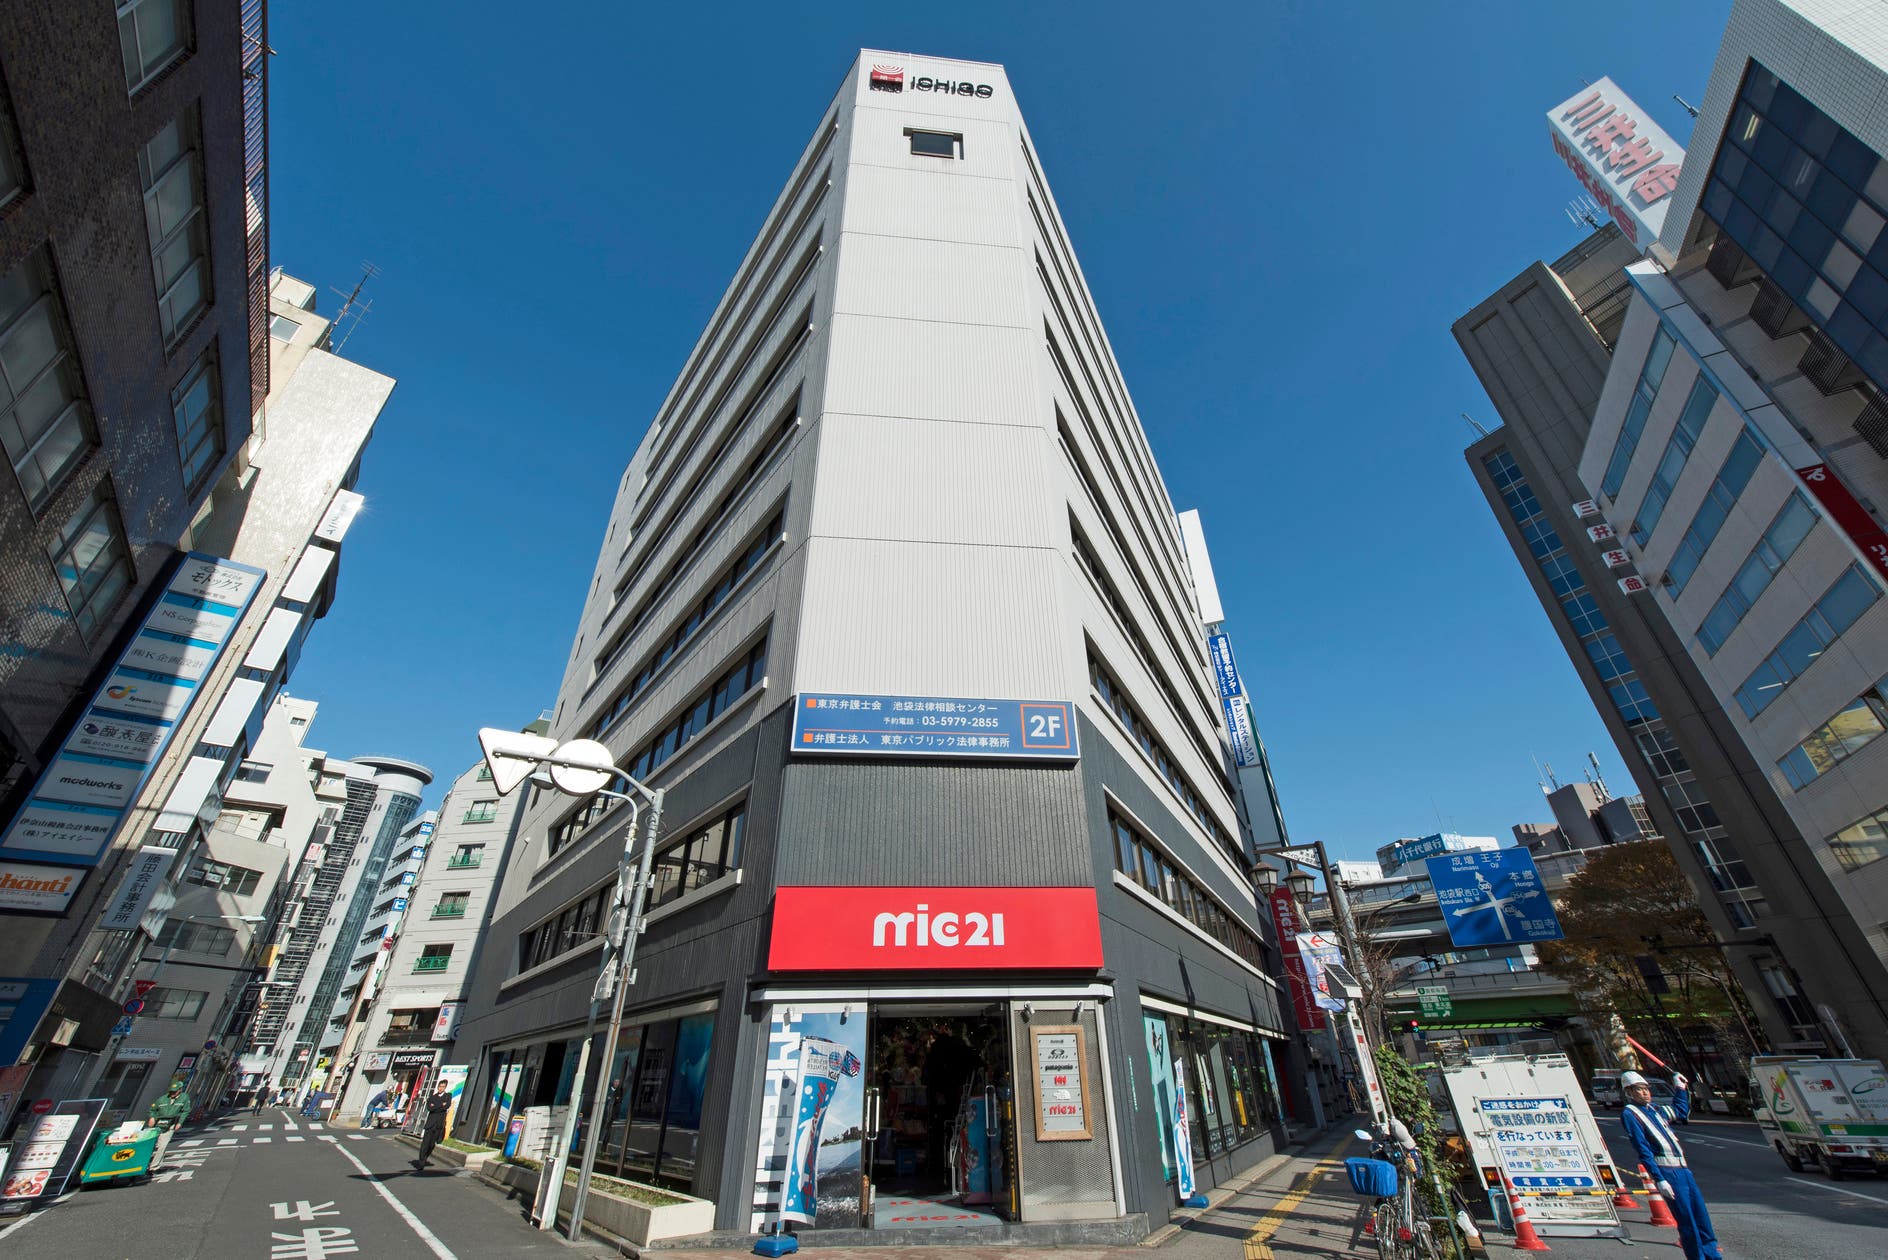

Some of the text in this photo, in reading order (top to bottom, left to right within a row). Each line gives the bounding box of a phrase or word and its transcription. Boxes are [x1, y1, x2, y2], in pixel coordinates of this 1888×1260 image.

[817, 699, 998, 714] 東京弁護士会 池袋法律相談センター
[922, 715, 999, 728] 03-5979-2855
[1030, 714, 1061, 738] 2F
[813, 733, 1010, 749] 弁護士法人 東京パブリック法律事務所
[1399, 837, 1443, 860] 八千代銀行
[1480, 852, 1503, 863] 王子
[0, 873, 73, 893] hanti
[1438, 887, 1480, 899] 池袋駅西口
[873, 904, 1005, 947] mic21
[1490, 1111, 1570, 1127] 電気設備の新設
[1497, 1130, 1573, 1142] を行なっています
